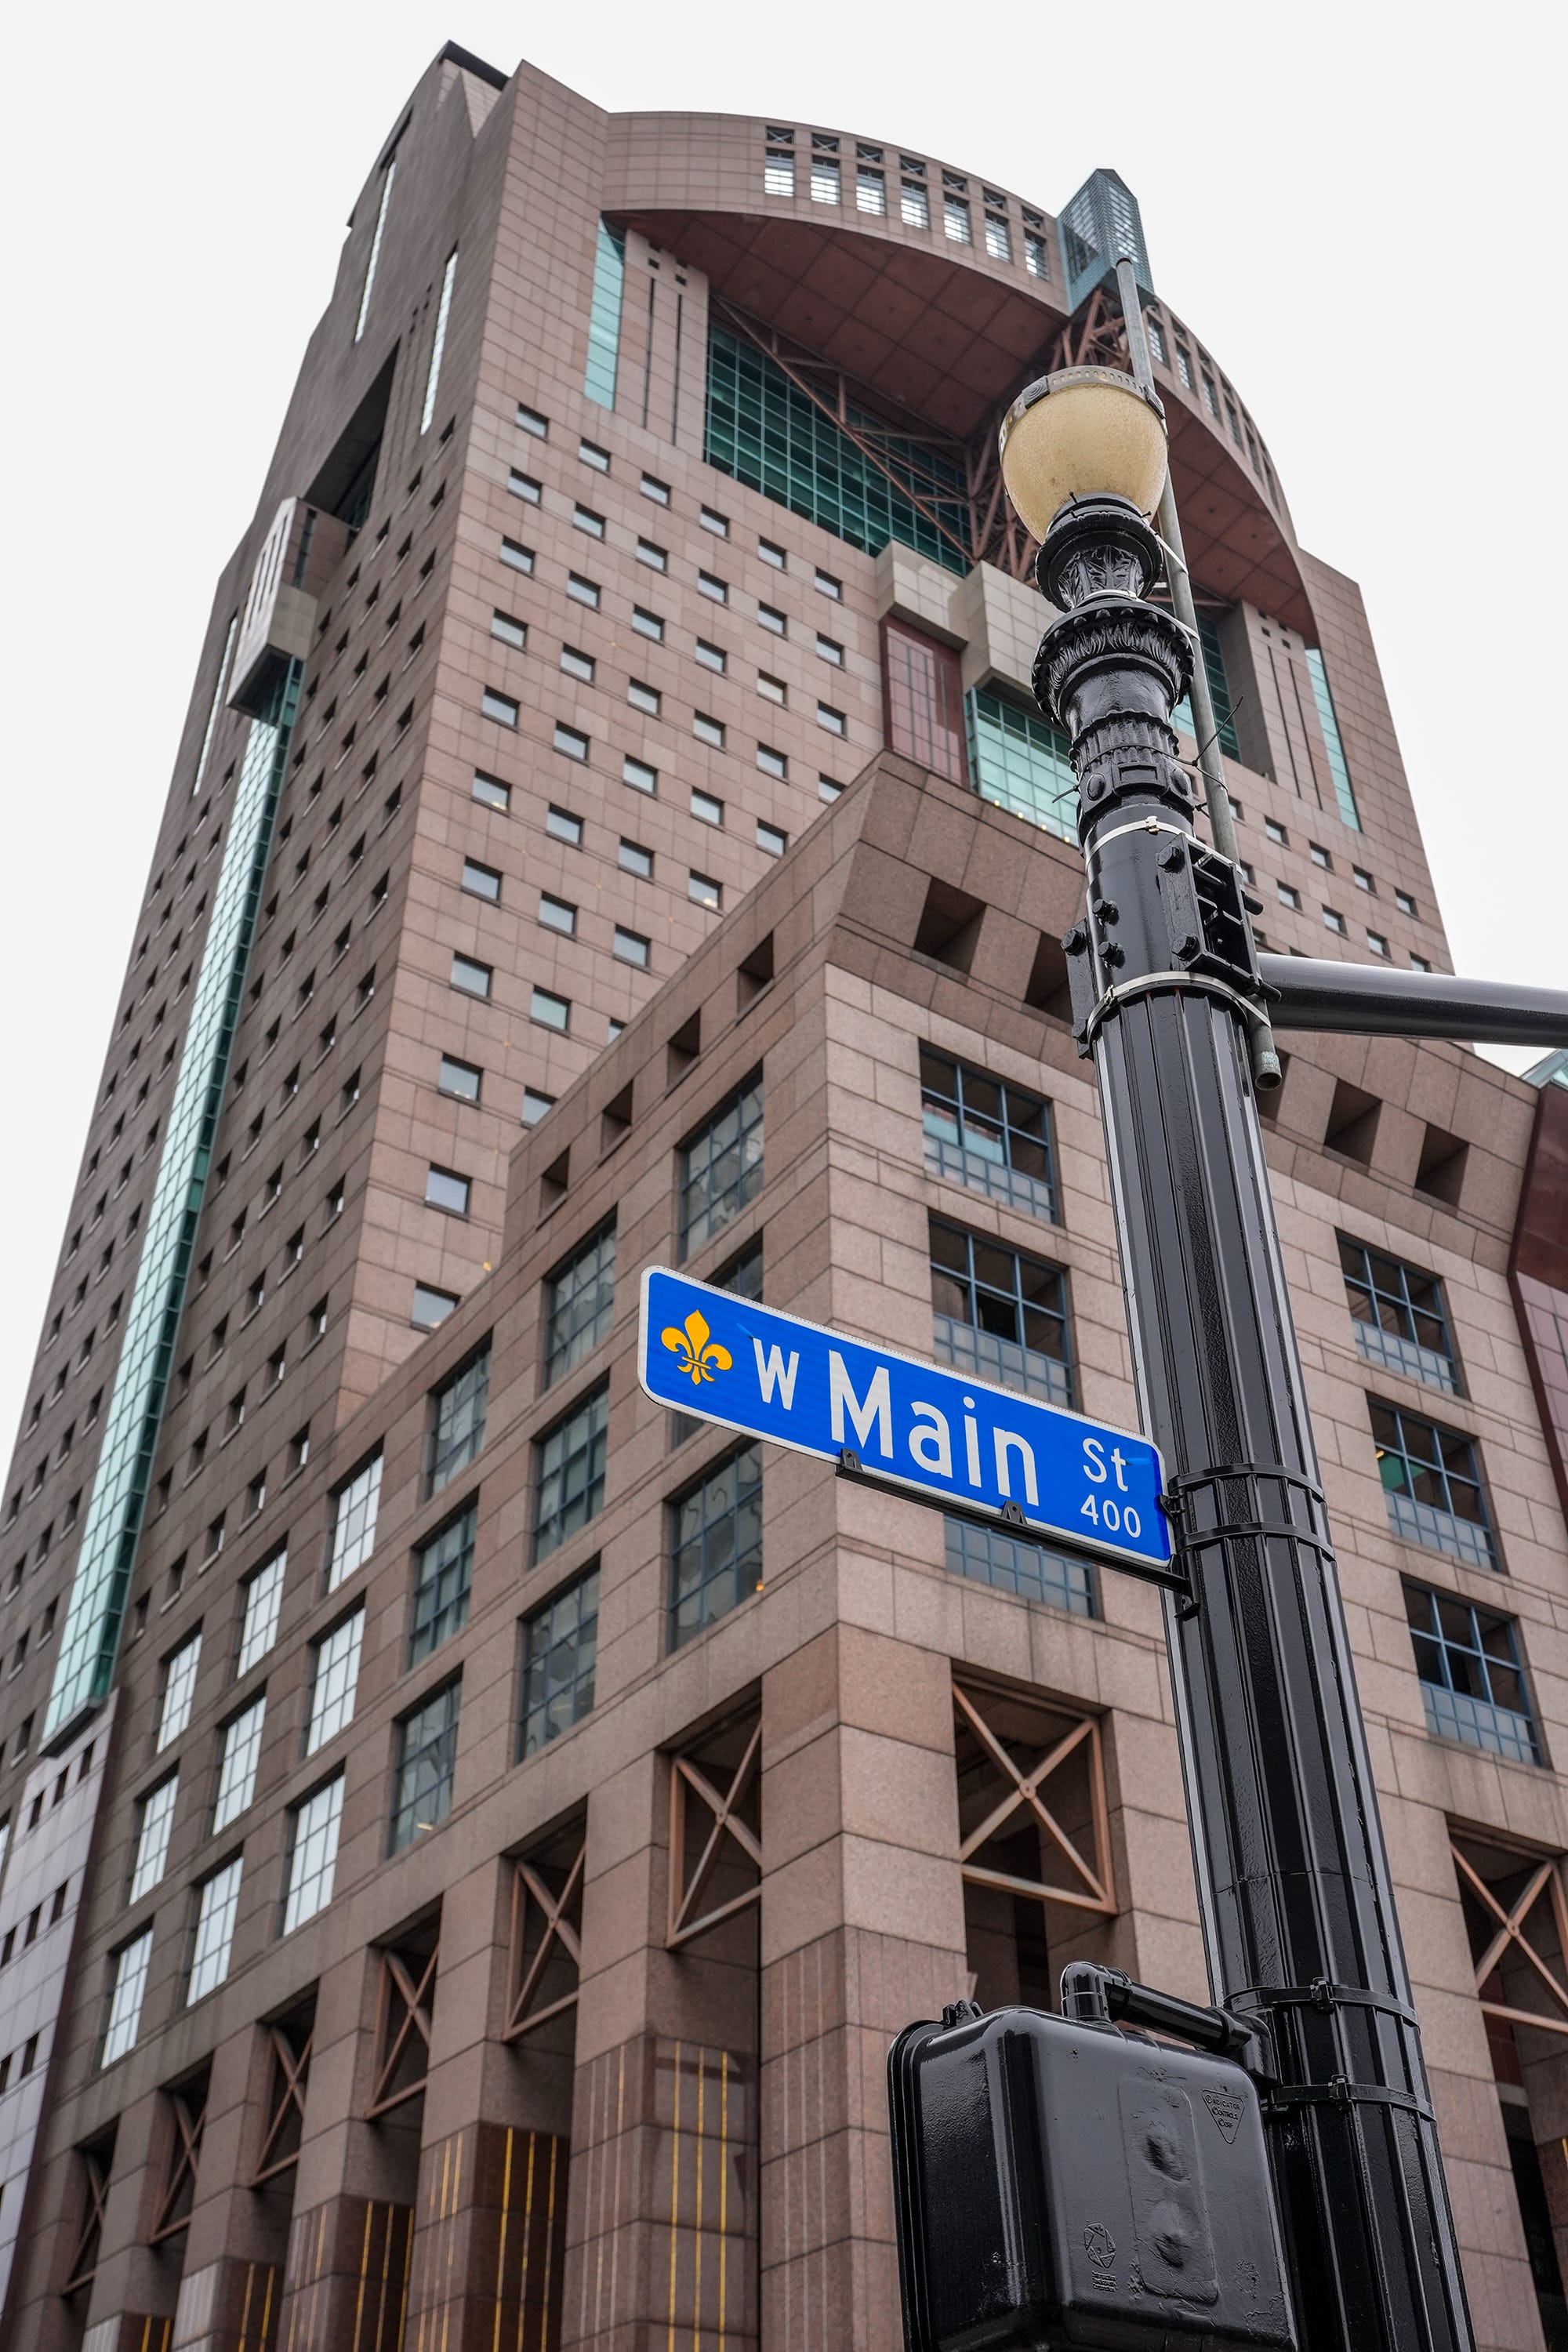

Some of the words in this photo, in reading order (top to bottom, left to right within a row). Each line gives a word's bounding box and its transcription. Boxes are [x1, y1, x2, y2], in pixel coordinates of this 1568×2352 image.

[752, 1337, 800, 1411] W
[829, 1349, 1039, 1507] Main
[1083, 1438, 1128, 1493] St
[1080, 1494, 1142, 1539] 400
